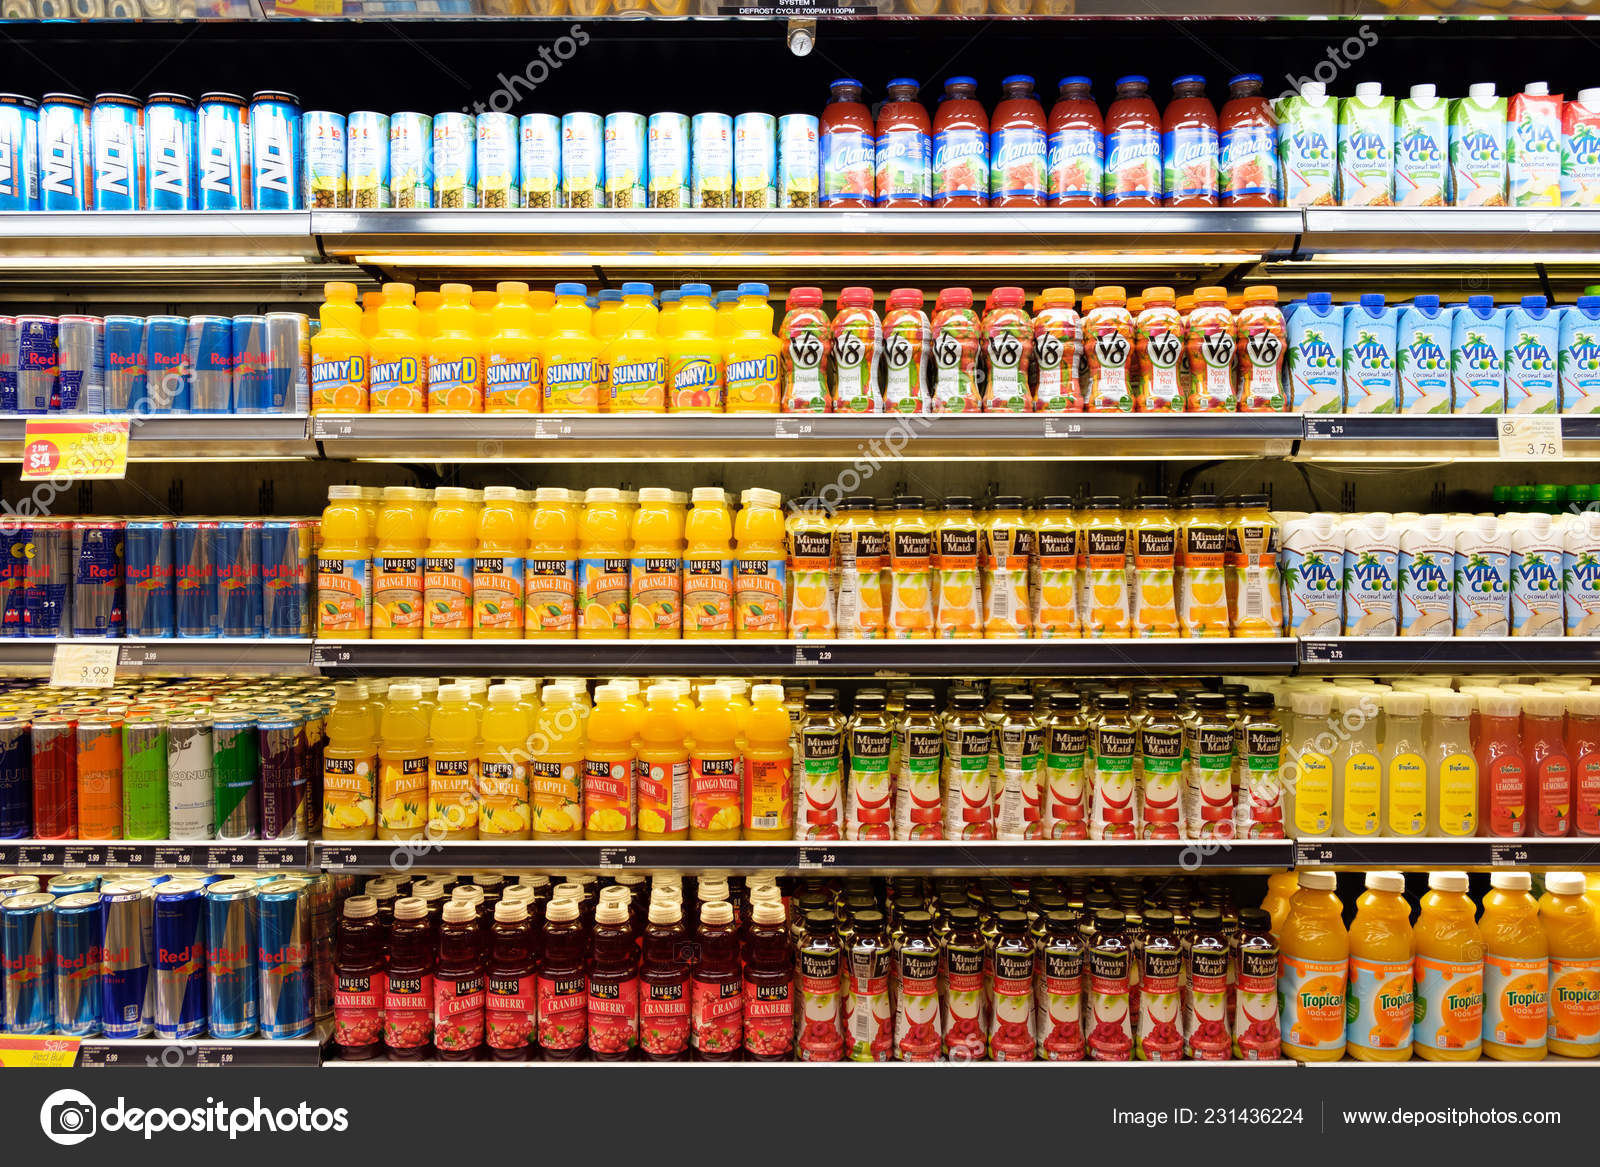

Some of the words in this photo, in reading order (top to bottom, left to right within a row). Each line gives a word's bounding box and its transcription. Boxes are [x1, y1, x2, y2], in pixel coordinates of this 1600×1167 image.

[1293, 134, 1327, 150] VITA
[1350, 134, 1383, 150] VITA
[1404, 134, 1438, 151] VITA
[1463, 134, 1497, 150] VITA
[935, 139, 984, 171] Clamato
[998, 139, 1046, 170] Clamato
[1110, 139, 1159, 171] Clamato
[1221, 136, 1272, 170] Clamato
[790, 331, 820, 365] V8
[833, 332, 860, 365] V8
[882, 333, 908, 366] V8
[934, 332, 957, 366] V8
[989, 330, 1019, 365] V8
[1034, 332, 1060, 365] V8
[1096, 330, 1127, 364] V8
[1149, 330, 1179, 364] V8
[1203, 330, 1233, 364] V8
[1248, 329, 1279, 365] V8
[1300, 343, 1335, 358] VITA
[1354, 344, 1388, 358] VITA
[1409, 344, 1444, 359] VITA
[1461, 344, 1497, 360] VITA
[1513, 344, 1548, 360] VITA
[30, 352, 56, 364] Red
[110, 352, 135, 364] Red
[154, 352, 179, 364] Red
[486, 357, 540, 384] SUNNYD
[547, 357, 598, 384] SUNNYD
[612, 357, 664, 384] SUNNYD
[675, 363, 716, 388] SUNNYD
[93, 423, 114, 433] Sale
[1331, 425, 1343, 434] 3.75
[1528, 443, 1555, 454] 3.75
[31, 453, 50, 468] $4
[797, 535, 829, 545] Minute
[899, 536, 930, 545] Minute
[943, 534, 975, 544] Minute
[1091, 533, 1124, 543] Minute
[1191, 532, 1225, 541] Minute
[802, 544, 825, 553] Maid
[904, 544, 927, 553] Maid
[948, 543, 971, 552] Maid
[1095, 541, 1120, 551] Maid
[1196, 540, 1222, 550] Maid
[128, 564, 150, 577] Red
[187, 564, 212, 577] Bull
[384, 559, 415, 570] LANGERS
[647, 560, 675, 572] LANGERS
[691, 561, 720, 573] LANGERS
[739, 561, 767, 573] LANGERS
[90, 565, 116, 577] Red
[1299, 564, 1335, 580] VITA
[1354, 564, 1390, 580] VITA
[1408, 564, 1444, 580] VITA
[1464, 566, 1500, 581] VITA
[1519, 564, 1555, 580] VITA
[377, 576, 405, 588] ORANGE
[442, 576, 462, 590] JUICE
[638, 576, 666, 589] ORANGE
[1330, 650, 1343, 659] 3.75
[81, 666, 109, 677] 3.99
[808, 737, 839, 747] Minute
[857, 736, 890, 745] Minute
[1103, 735, 1135, 744] Minute
[1144, 735, 1179, 745] Minute
[812, 746, 835, 755] Maid
[862, 744, 886, 753] Maid
[1107, 744, 1131, 753] Maid
[1149, 745, 1174, 754] Maid
[326, 760, 353, 770] LANGERS
[437, 761, 467, 771] LANGERS
[483, 764, 512, 775] LANGERS
[704, 760, 732, 771] LANGERS
[594, 780, 617, 793] NECTAR
[696, 780, 718, 791] MANGO
[1496, 782, 1524, 790] LEMONADE
[159, 948, 189, 963] Red
[218, 945, 248, 962] Bull
[259, 948, 283, 962] Red
[952, 953, 981, 963] Minute
[804, 957, 835, 967] Minute
[956, 962, 977, 972] Maid
[807, 966, 831, 976] Maid
[339, 977, 369, 988] LANGERS
[390, 978, 420, 989] LANGERS
[490, 980, 518, 990] LANGERS
[652, 986, 681, 997] LANGERS
[757, 986, 787, 997] LANGERS
[44, 1040, 68, 1051] Sale
